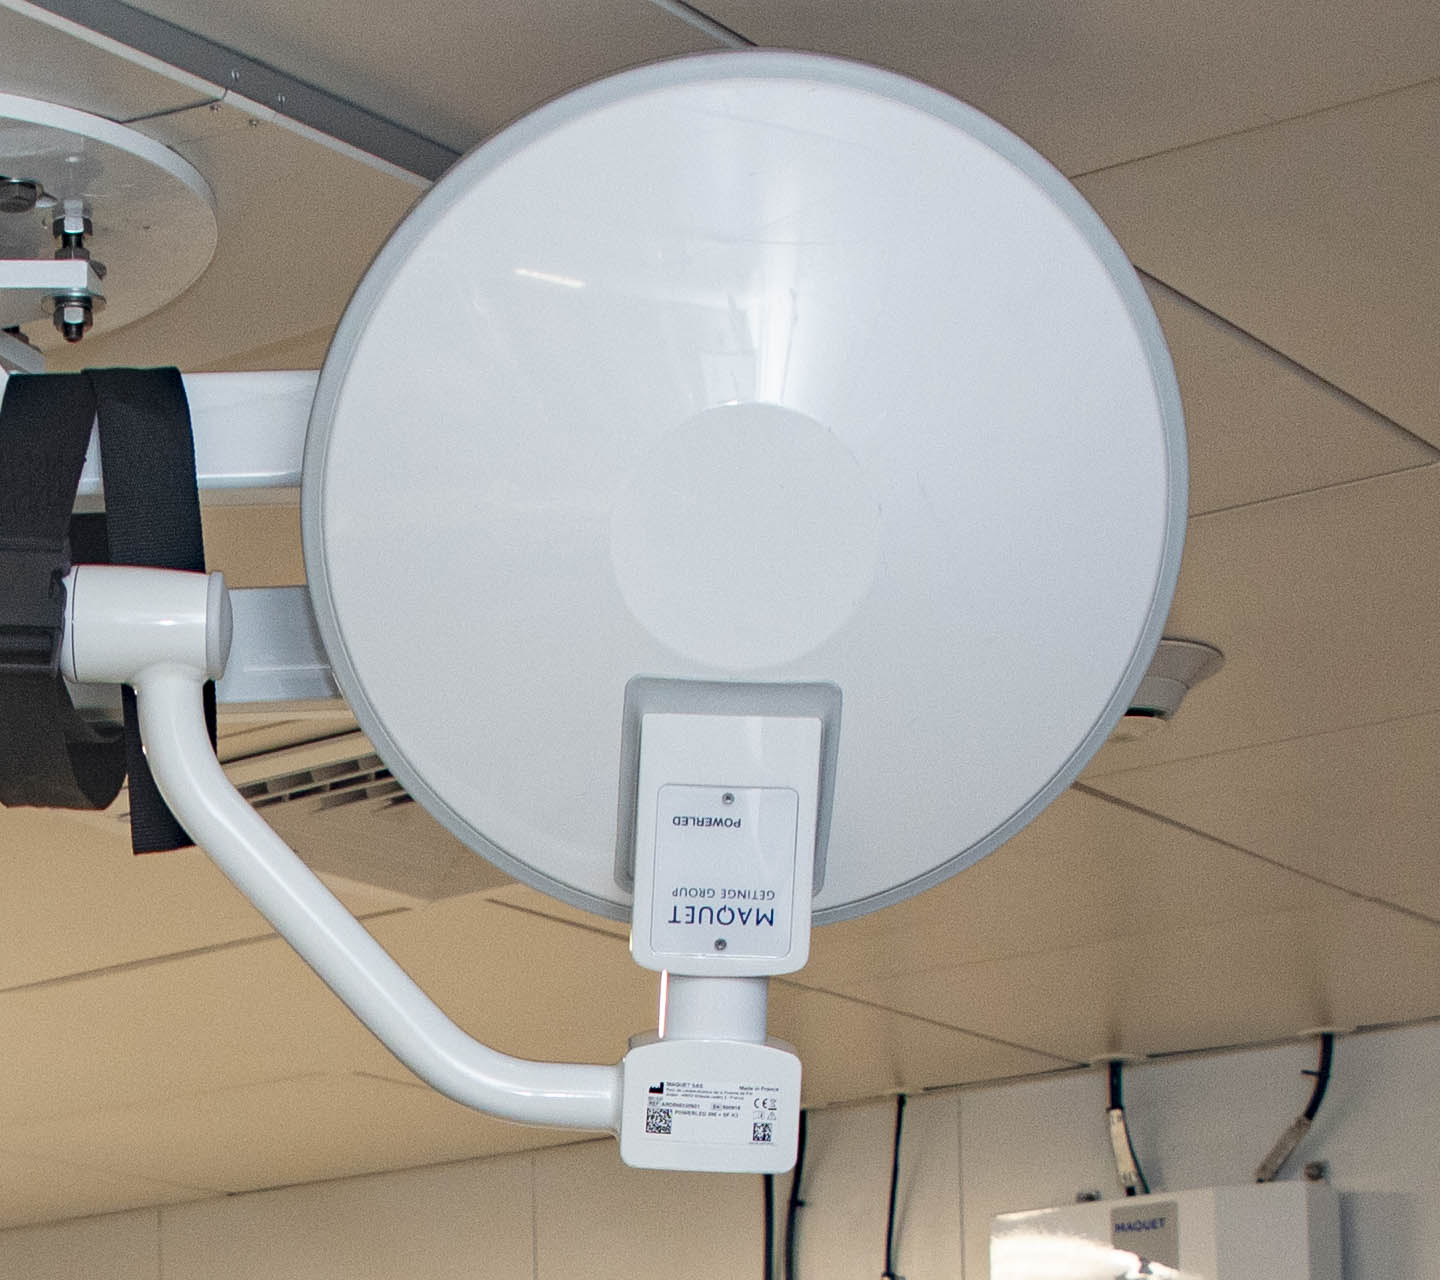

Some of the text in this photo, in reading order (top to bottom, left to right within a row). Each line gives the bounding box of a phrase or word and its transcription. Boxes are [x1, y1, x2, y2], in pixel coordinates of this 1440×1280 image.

[672, 815, 742, 829] POWERLED
[671, 887, 776, 901] GETINGE GROUP
[667, 904, 775, 927] MAQUET
